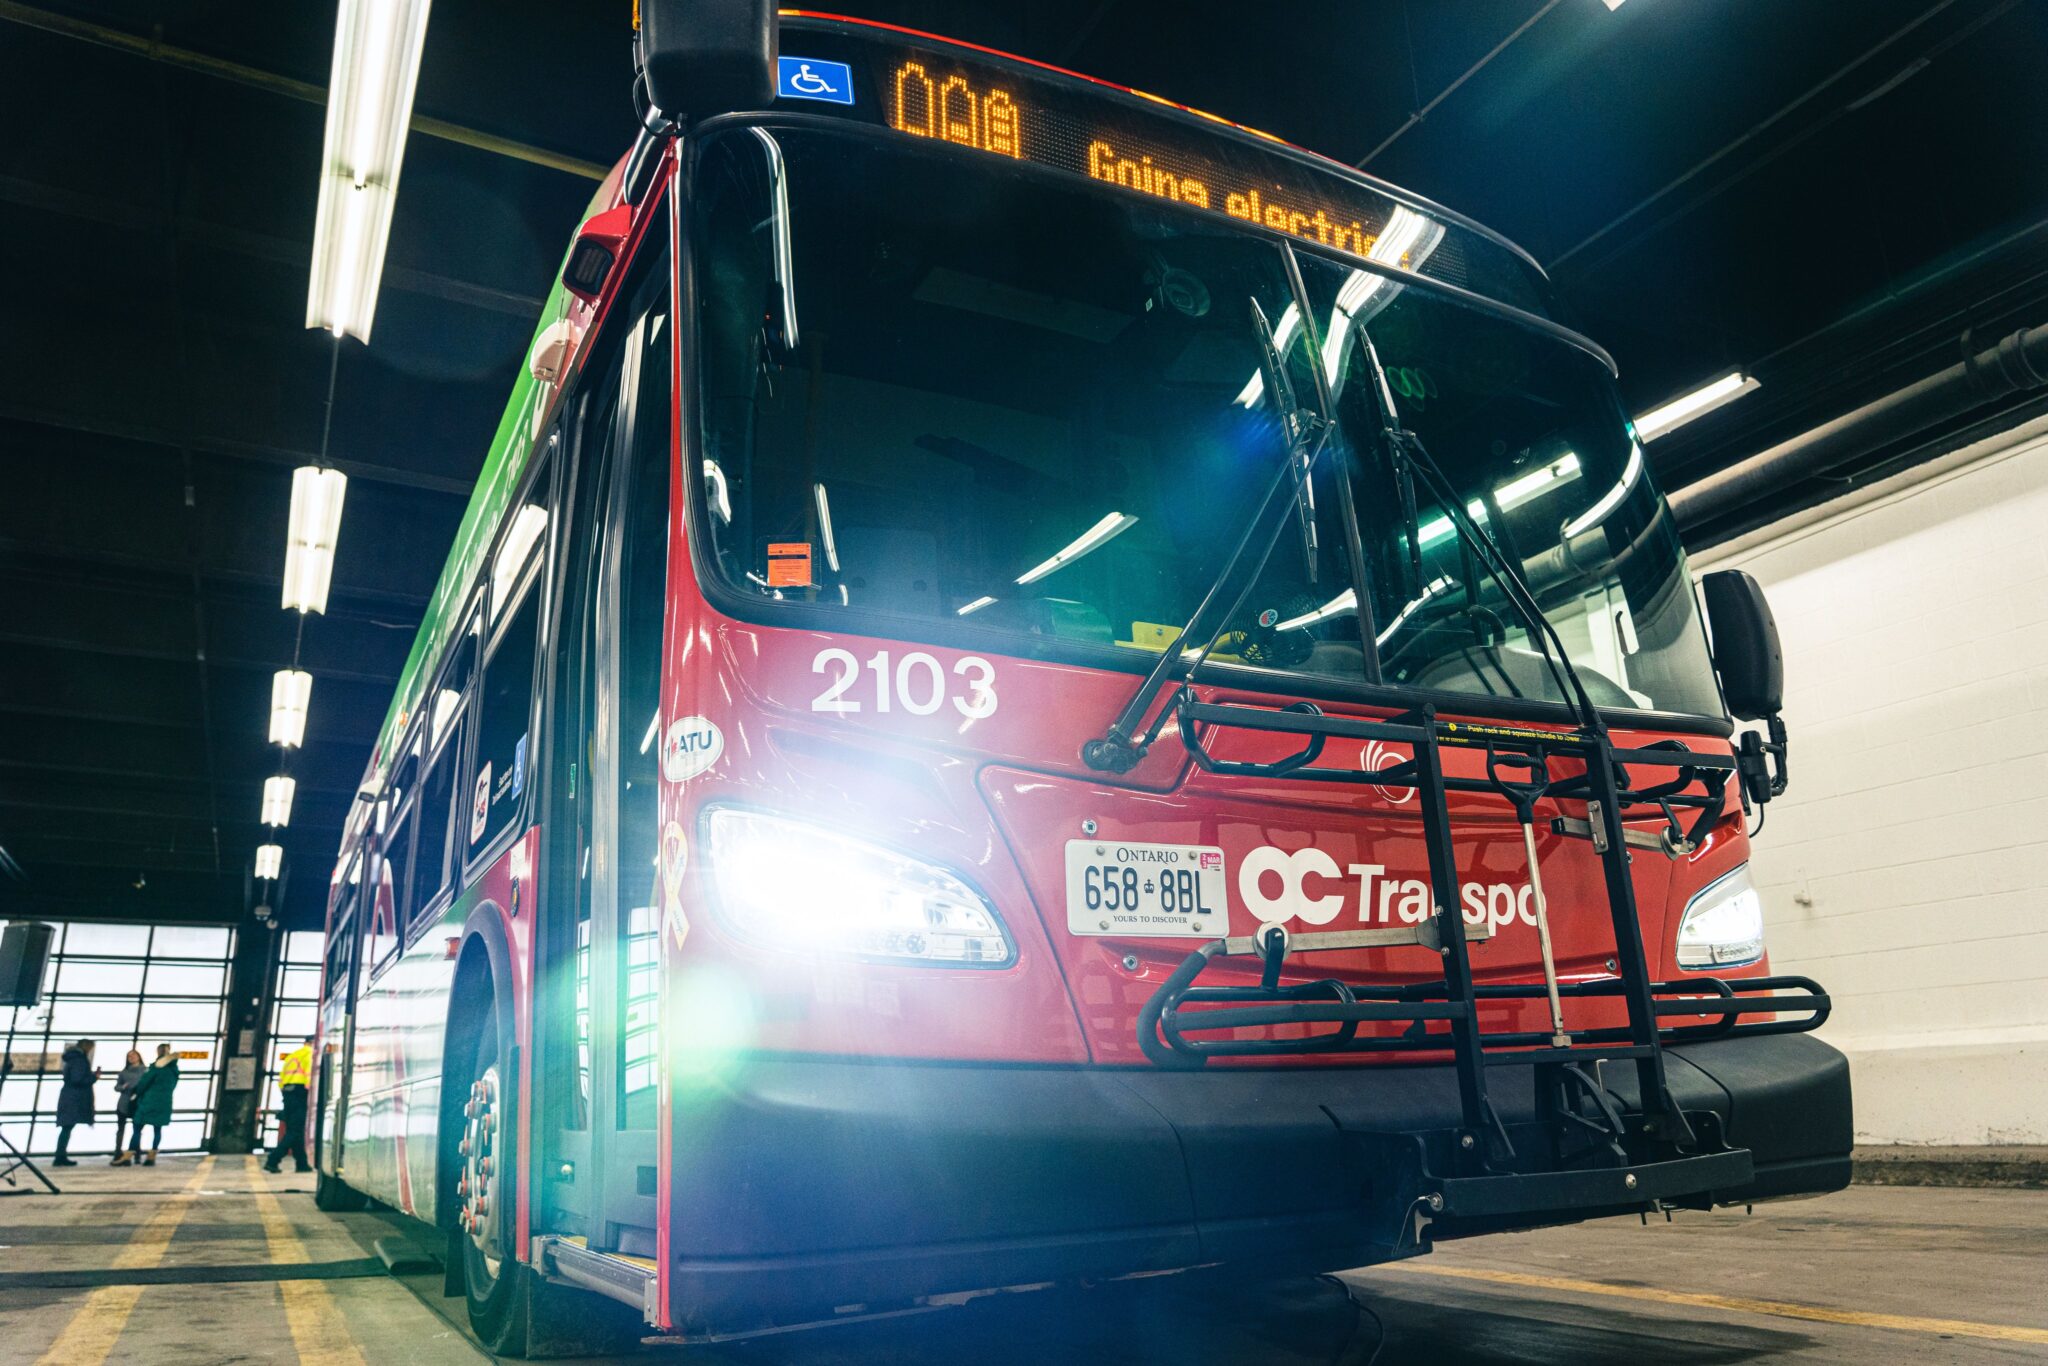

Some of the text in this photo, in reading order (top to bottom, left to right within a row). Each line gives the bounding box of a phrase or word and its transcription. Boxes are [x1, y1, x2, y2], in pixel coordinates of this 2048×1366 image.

[811, 647, 998, 719] 2103
[680, 730, 713, 753] ATU
[1116, 847, 1179, 864] ONTARIO
[1085, 865, 1212, 914] 658 8BL
[1238, 846, 1547, 937] OC Traspo
[1113, 915, 1188, 924] YOURS TO DISCOVER
